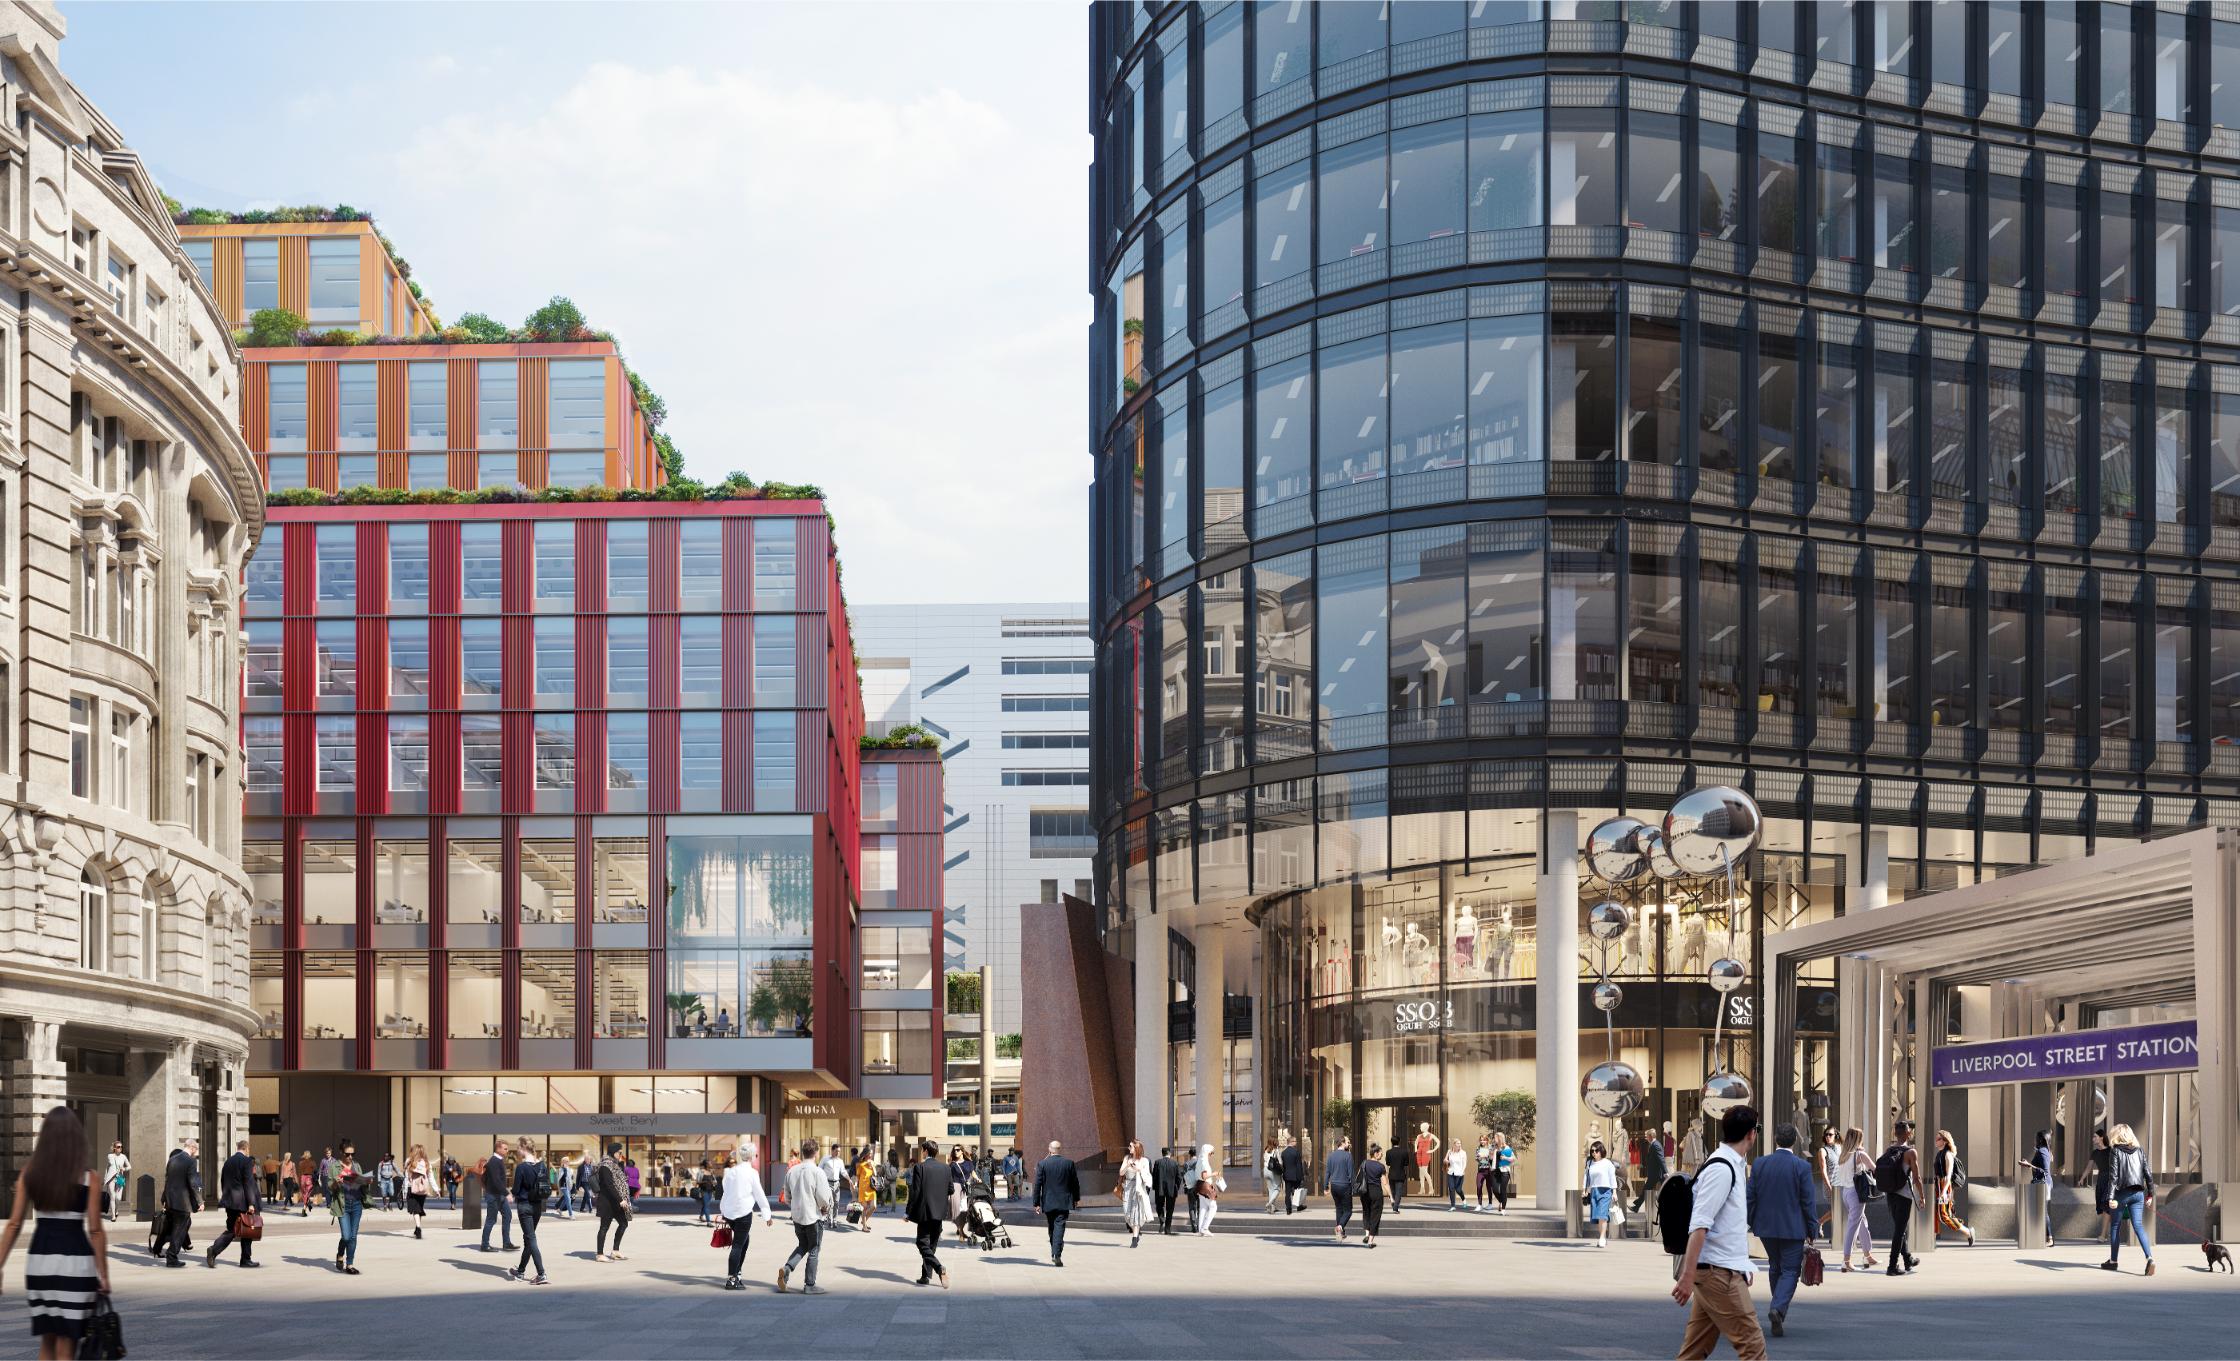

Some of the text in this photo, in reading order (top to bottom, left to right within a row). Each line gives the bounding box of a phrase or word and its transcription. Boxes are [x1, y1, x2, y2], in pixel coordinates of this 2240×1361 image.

[1951, 1036, 2198, 1074] LIVERPOOL STREET STATION
[795, 1104, 836, 1115] MOGNA
[590, 1115, 658, 1127] Sweet Beryl
